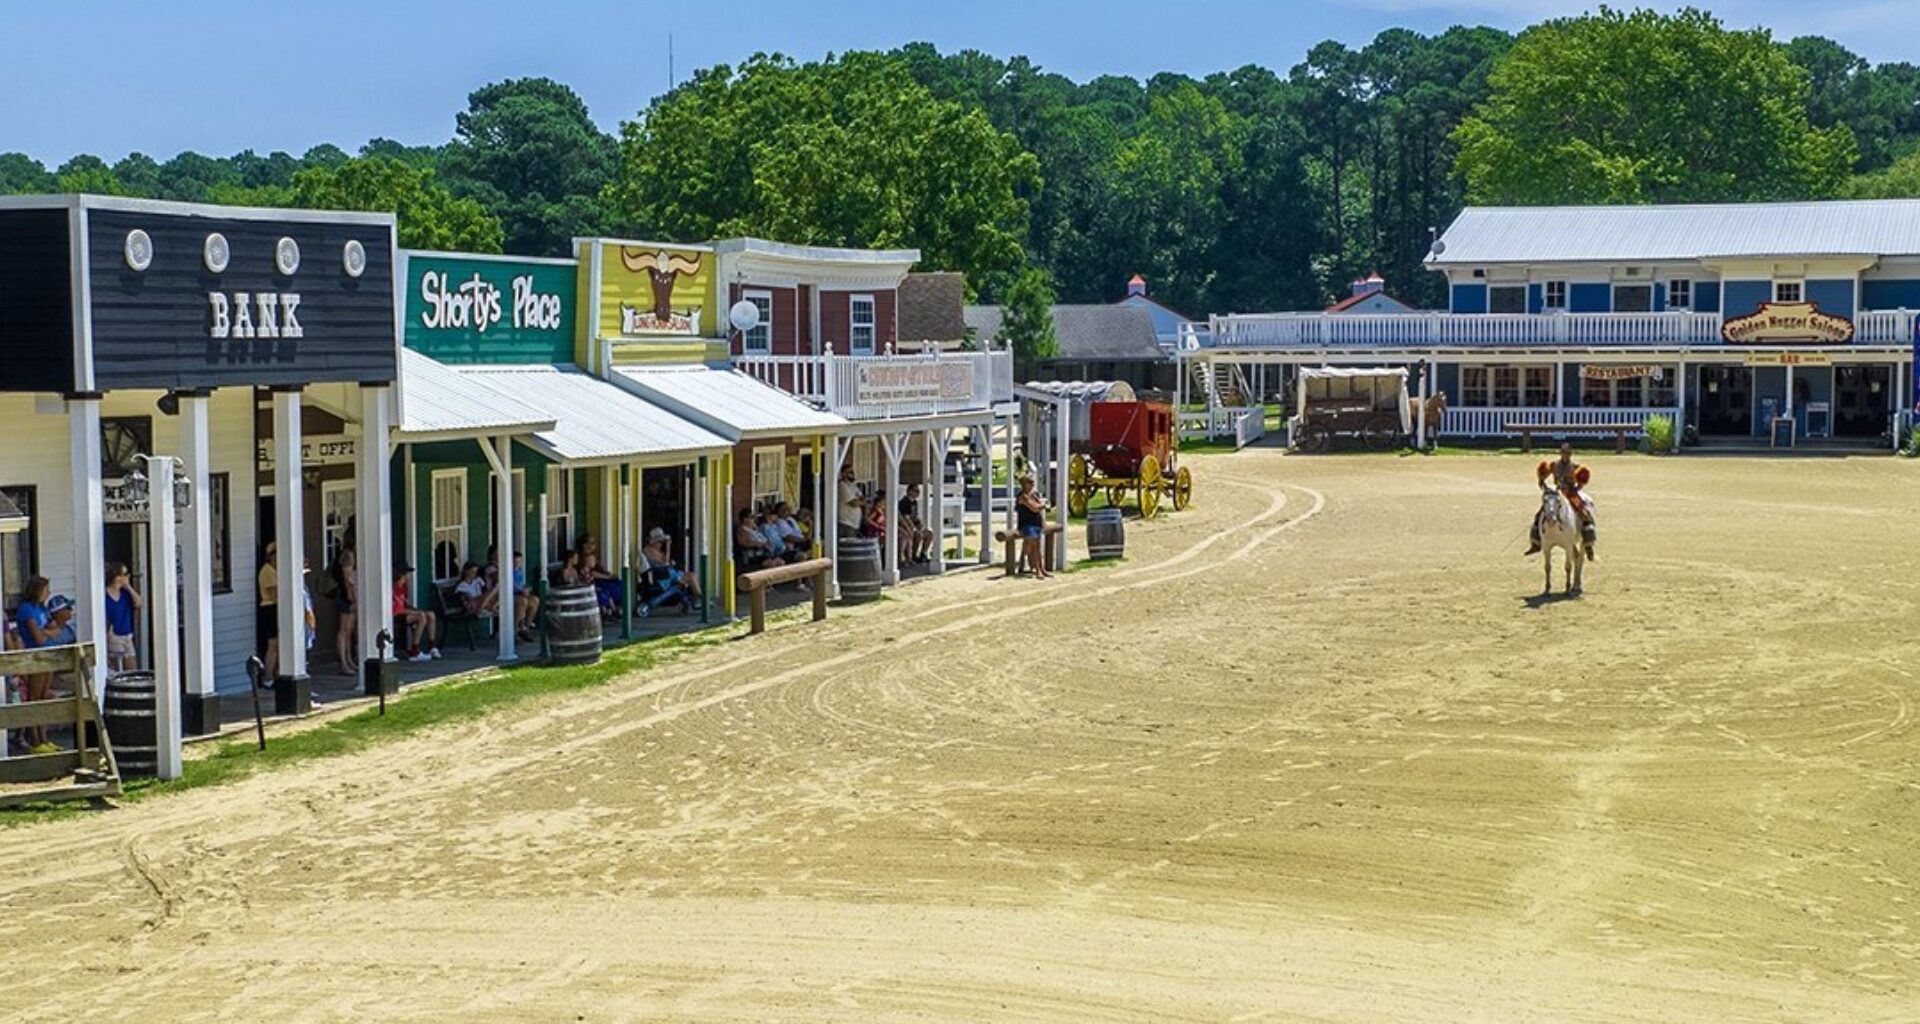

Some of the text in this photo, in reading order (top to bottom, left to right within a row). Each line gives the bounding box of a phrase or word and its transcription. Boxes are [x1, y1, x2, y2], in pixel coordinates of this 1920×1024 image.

[208, 291, 304, 338] BANK
[421, 270, 562, 333] Shorty's Place
[1729, 319, 1767, 338] Golden
[1809, 316, 1846, 338] Saloon
[319, 441, 355, 457] OFFI
